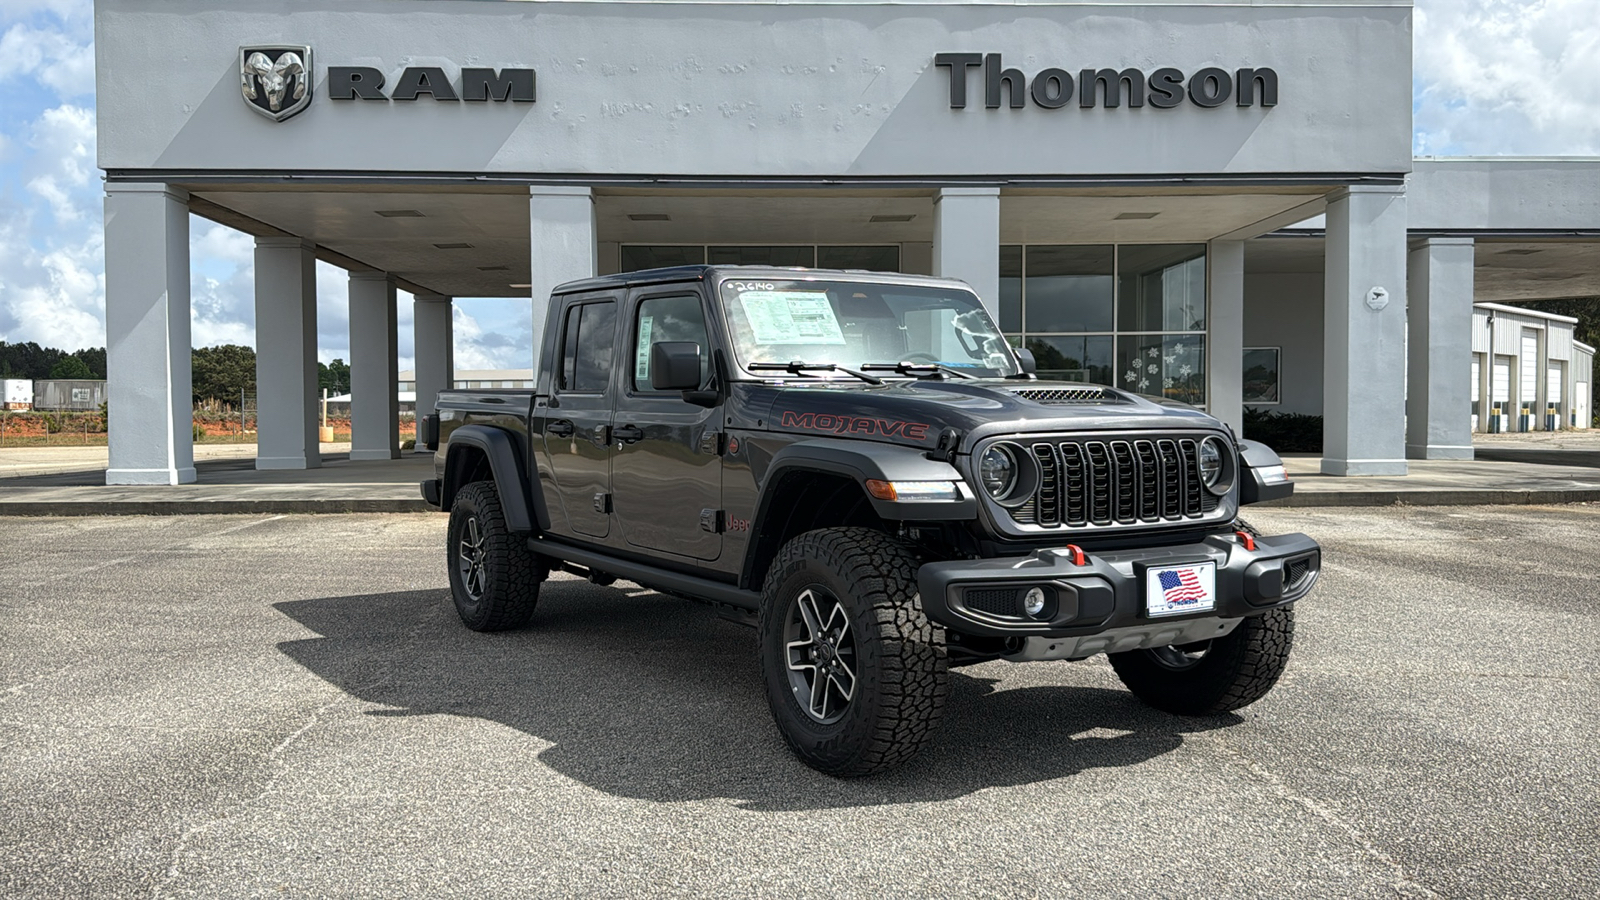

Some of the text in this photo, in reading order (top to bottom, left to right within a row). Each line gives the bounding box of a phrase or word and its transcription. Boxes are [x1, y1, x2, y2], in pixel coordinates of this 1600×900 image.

[327, 66, 537, 103] RAM
[934, 52, 1279, 109] Thomson
[781, 411, 930, 440] MOJAVE
